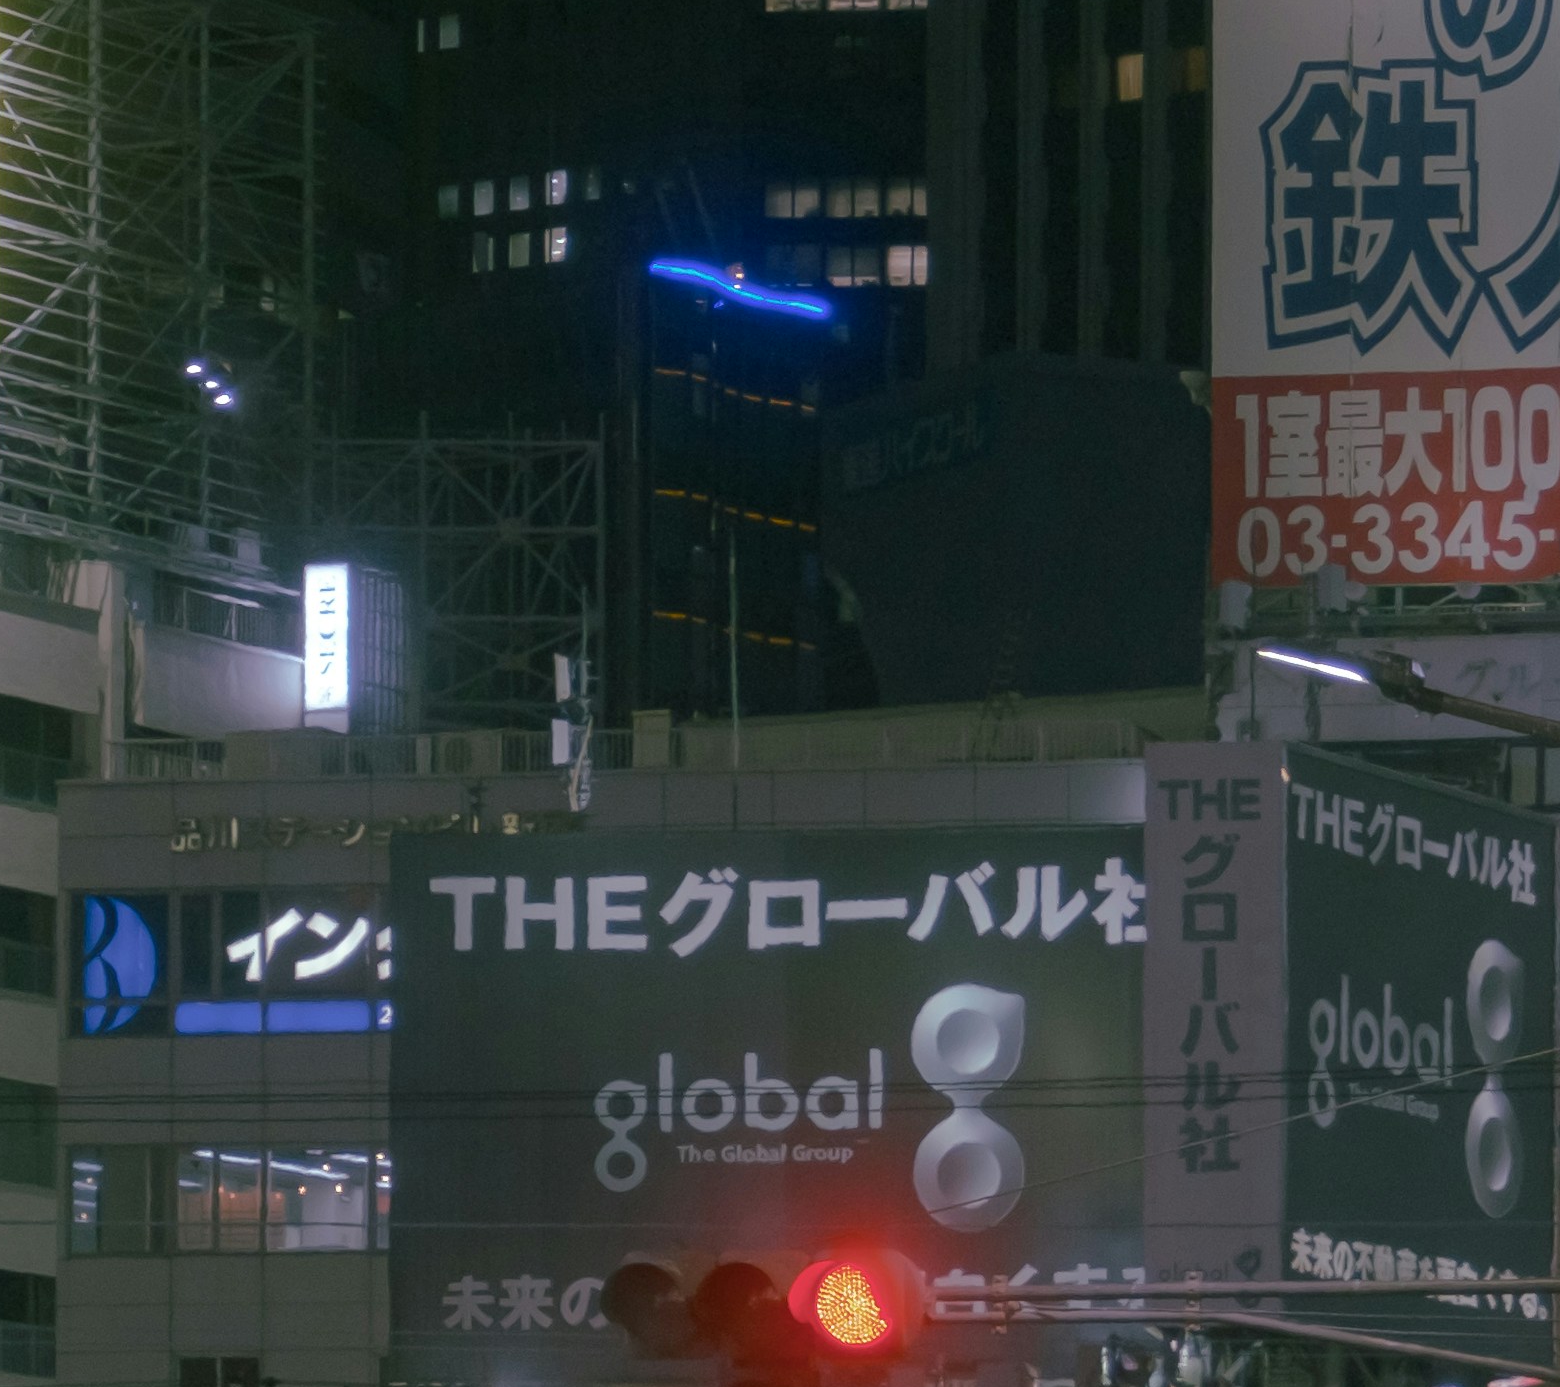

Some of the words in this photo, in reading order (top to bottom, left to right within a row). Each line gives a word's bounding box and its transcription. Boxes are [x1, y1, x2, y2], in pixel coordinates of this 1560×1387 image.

[1158, 778, 1261, 820] THE
[1290, 781, 1537, 906] THEグローバル社
[429, 855, 1146, 958] THEグローバル社
[1179, 832, 1240, 1174] グローバル社
[1308, 974, 1453, 1129] global
[594, 1049, 886, 1192] global
[678, 1145, 716, 1164] The
[721, 1144, 788, 1164] Global
[793, 1145, 854, 1166] Group
